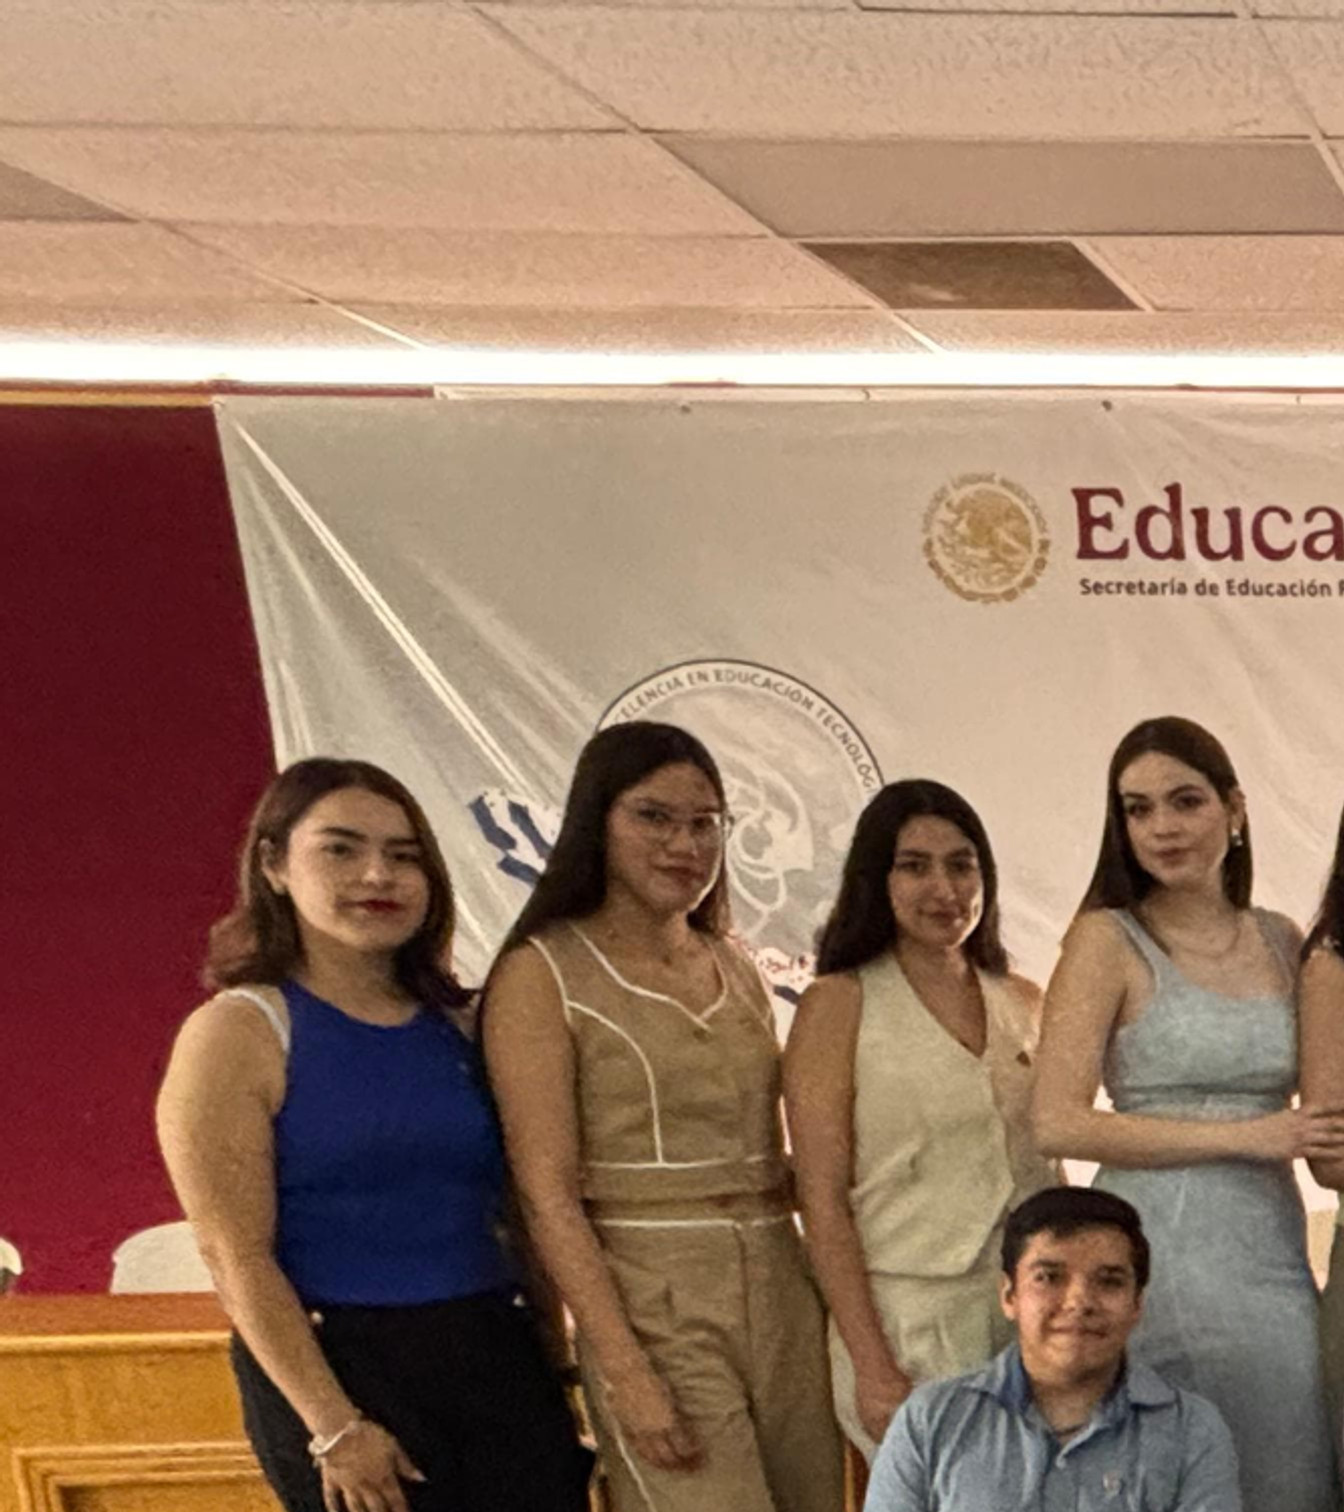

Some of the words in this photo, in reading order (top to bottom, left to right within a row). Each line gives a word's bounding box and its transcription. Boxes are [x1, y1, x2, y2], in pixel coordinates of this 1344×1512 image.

[1079, 577, 1188, 597] Secretaría
[1194, 578, 1220, 597] de
[1226, 578, 1332, 598] Educación
[614, 675, 684, 724] CELENCIA
[686, 671, 710, 686] EN
